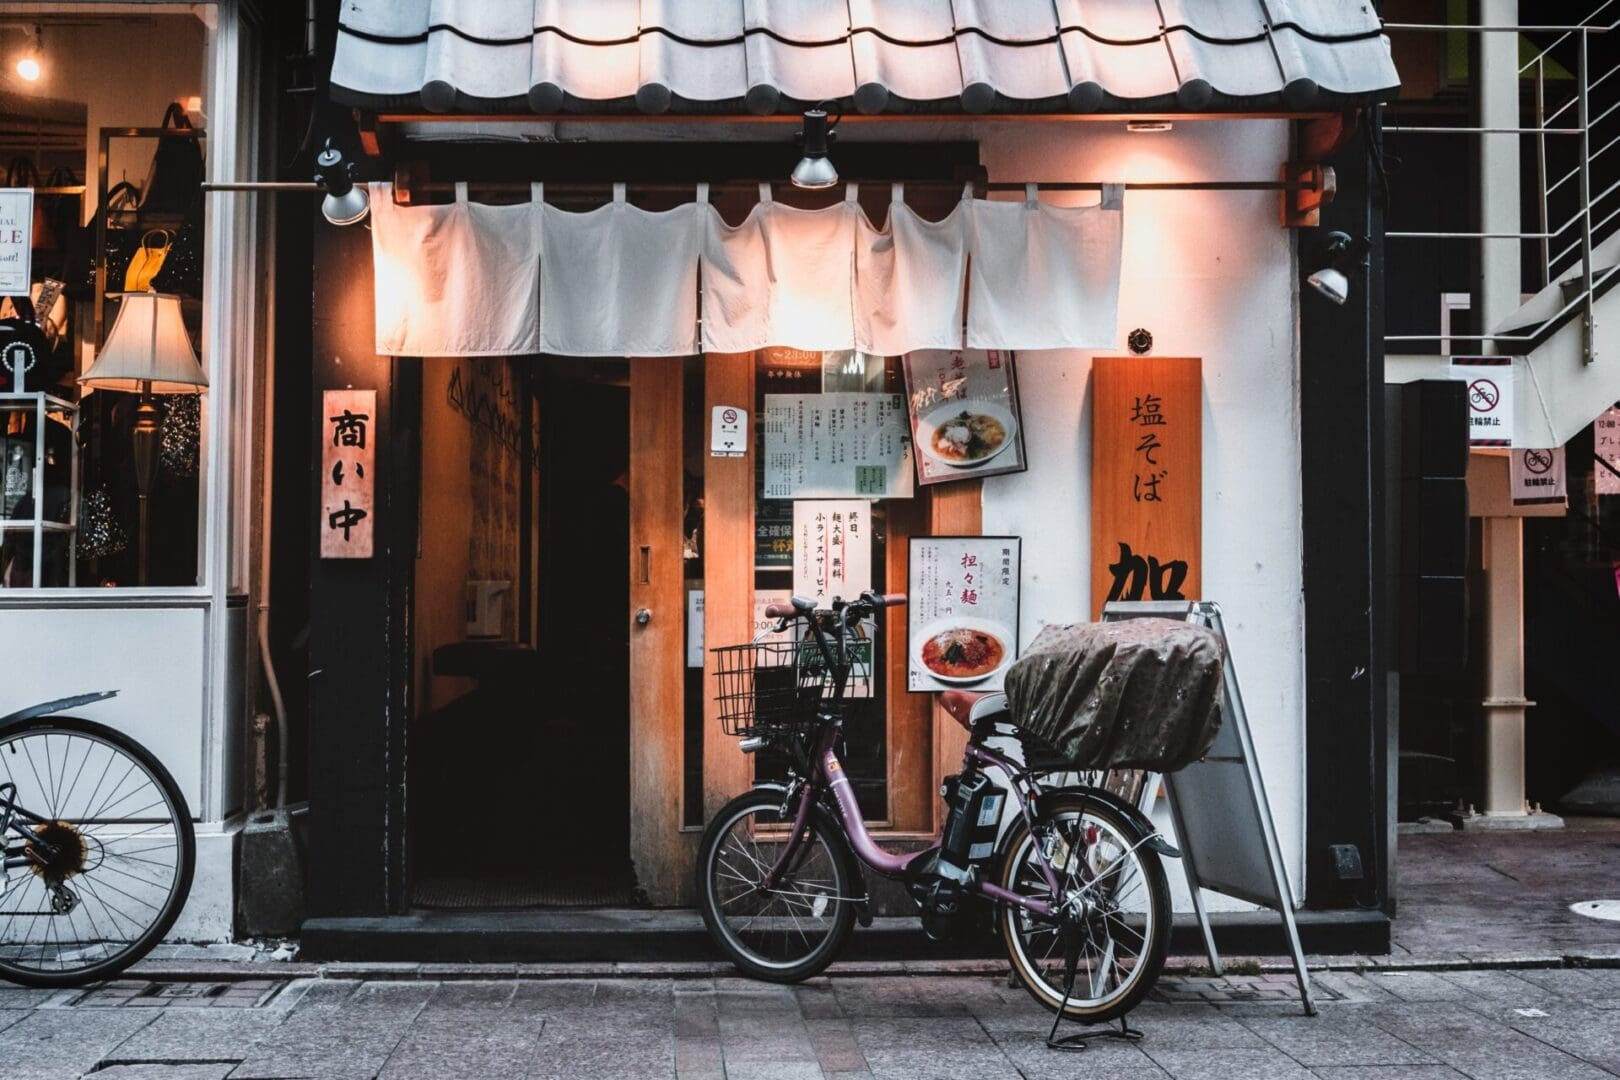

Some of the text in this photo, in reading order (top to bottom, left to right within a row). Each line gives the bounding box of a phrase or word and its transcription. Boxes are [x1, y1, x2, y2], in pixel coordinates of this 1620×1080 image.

[1130, 394, 1168, 502] 塩そば
[329, 409, 369, 542] 商い中
[1524, 477, 1556, 487] 駐輪禁止
[757, 525, 792, 537] 全確保
[815, 512, 825, 597] 小ライスサービス
[832, 558, 842, 578] 無料
[960, 552, 978, 606] 担々麺
[1002, 548, 1011, 586] 期間限定
[1106, 542, 1188, 601] 加
